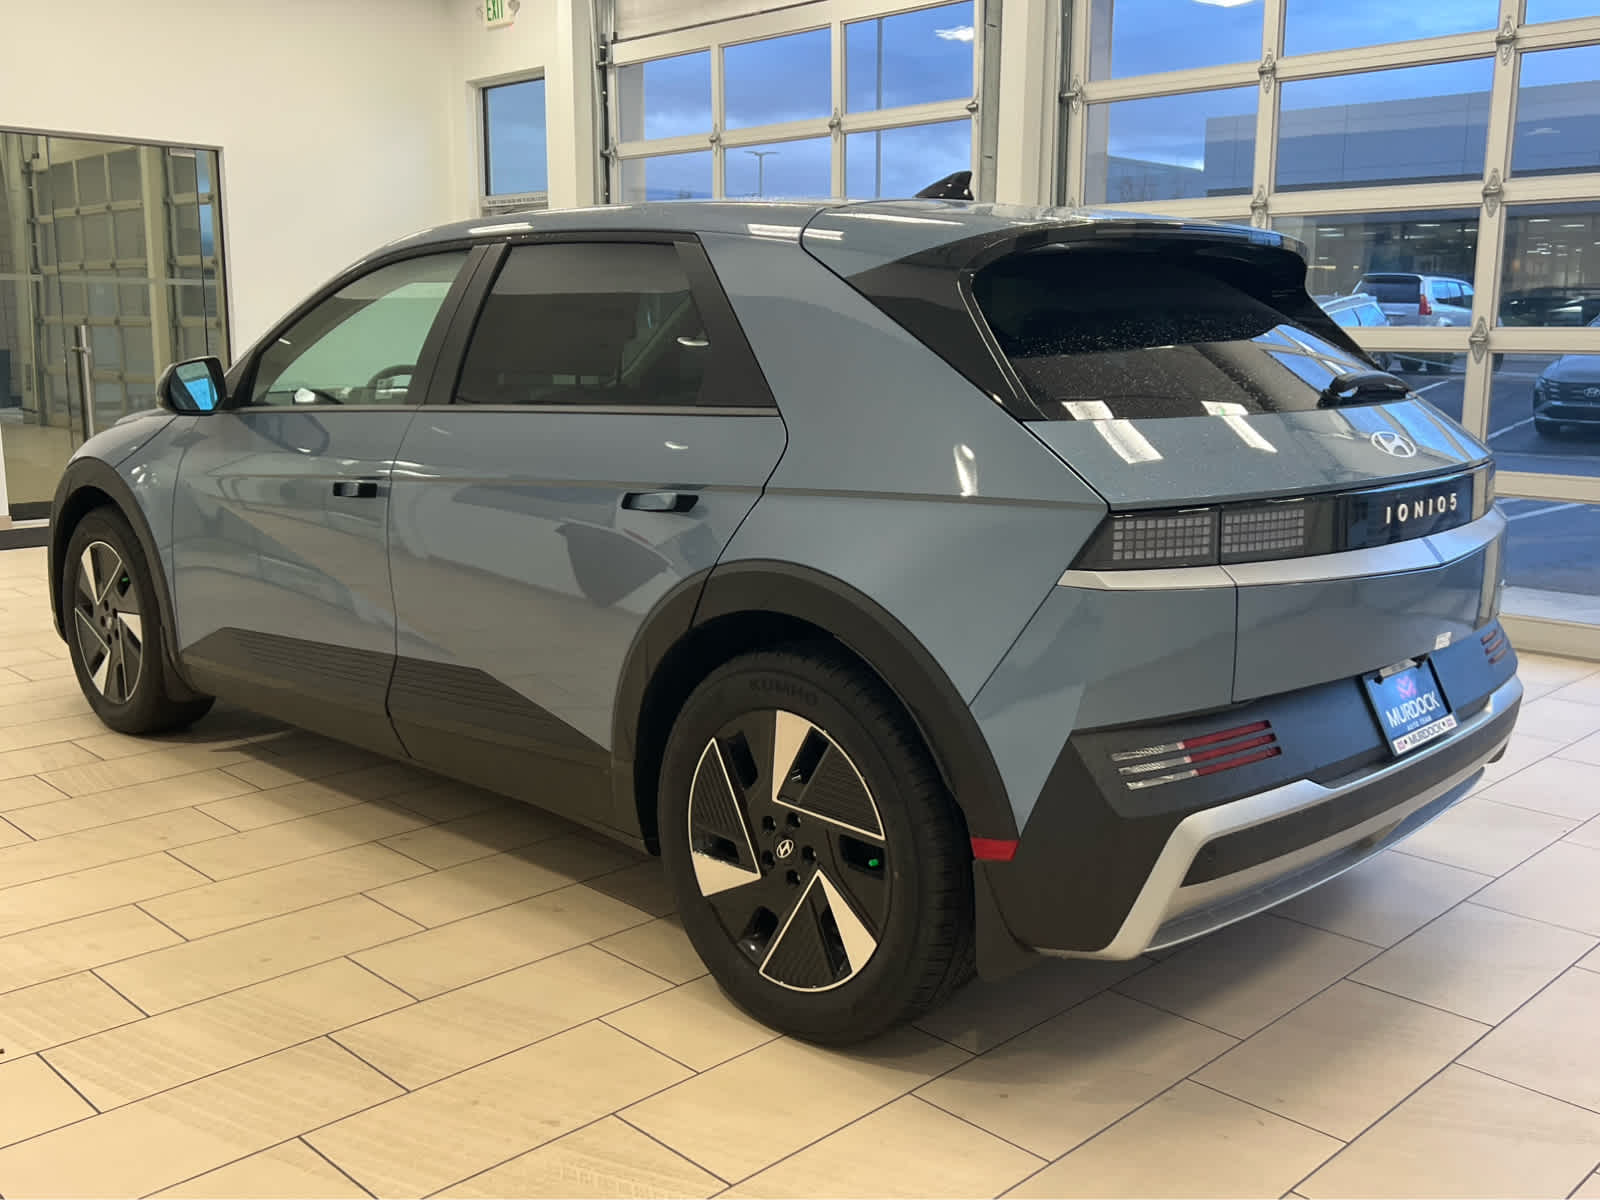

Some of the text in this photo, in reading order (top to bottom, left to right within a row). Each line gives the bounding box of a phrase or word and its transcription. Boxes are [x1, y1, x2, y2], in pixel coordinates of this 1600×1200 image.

[486, 0, 504, 21] EXIT
[1385, 691, 1440, 728] MURDOCK
[1408, 722, 1445, 744] MURDOCK
